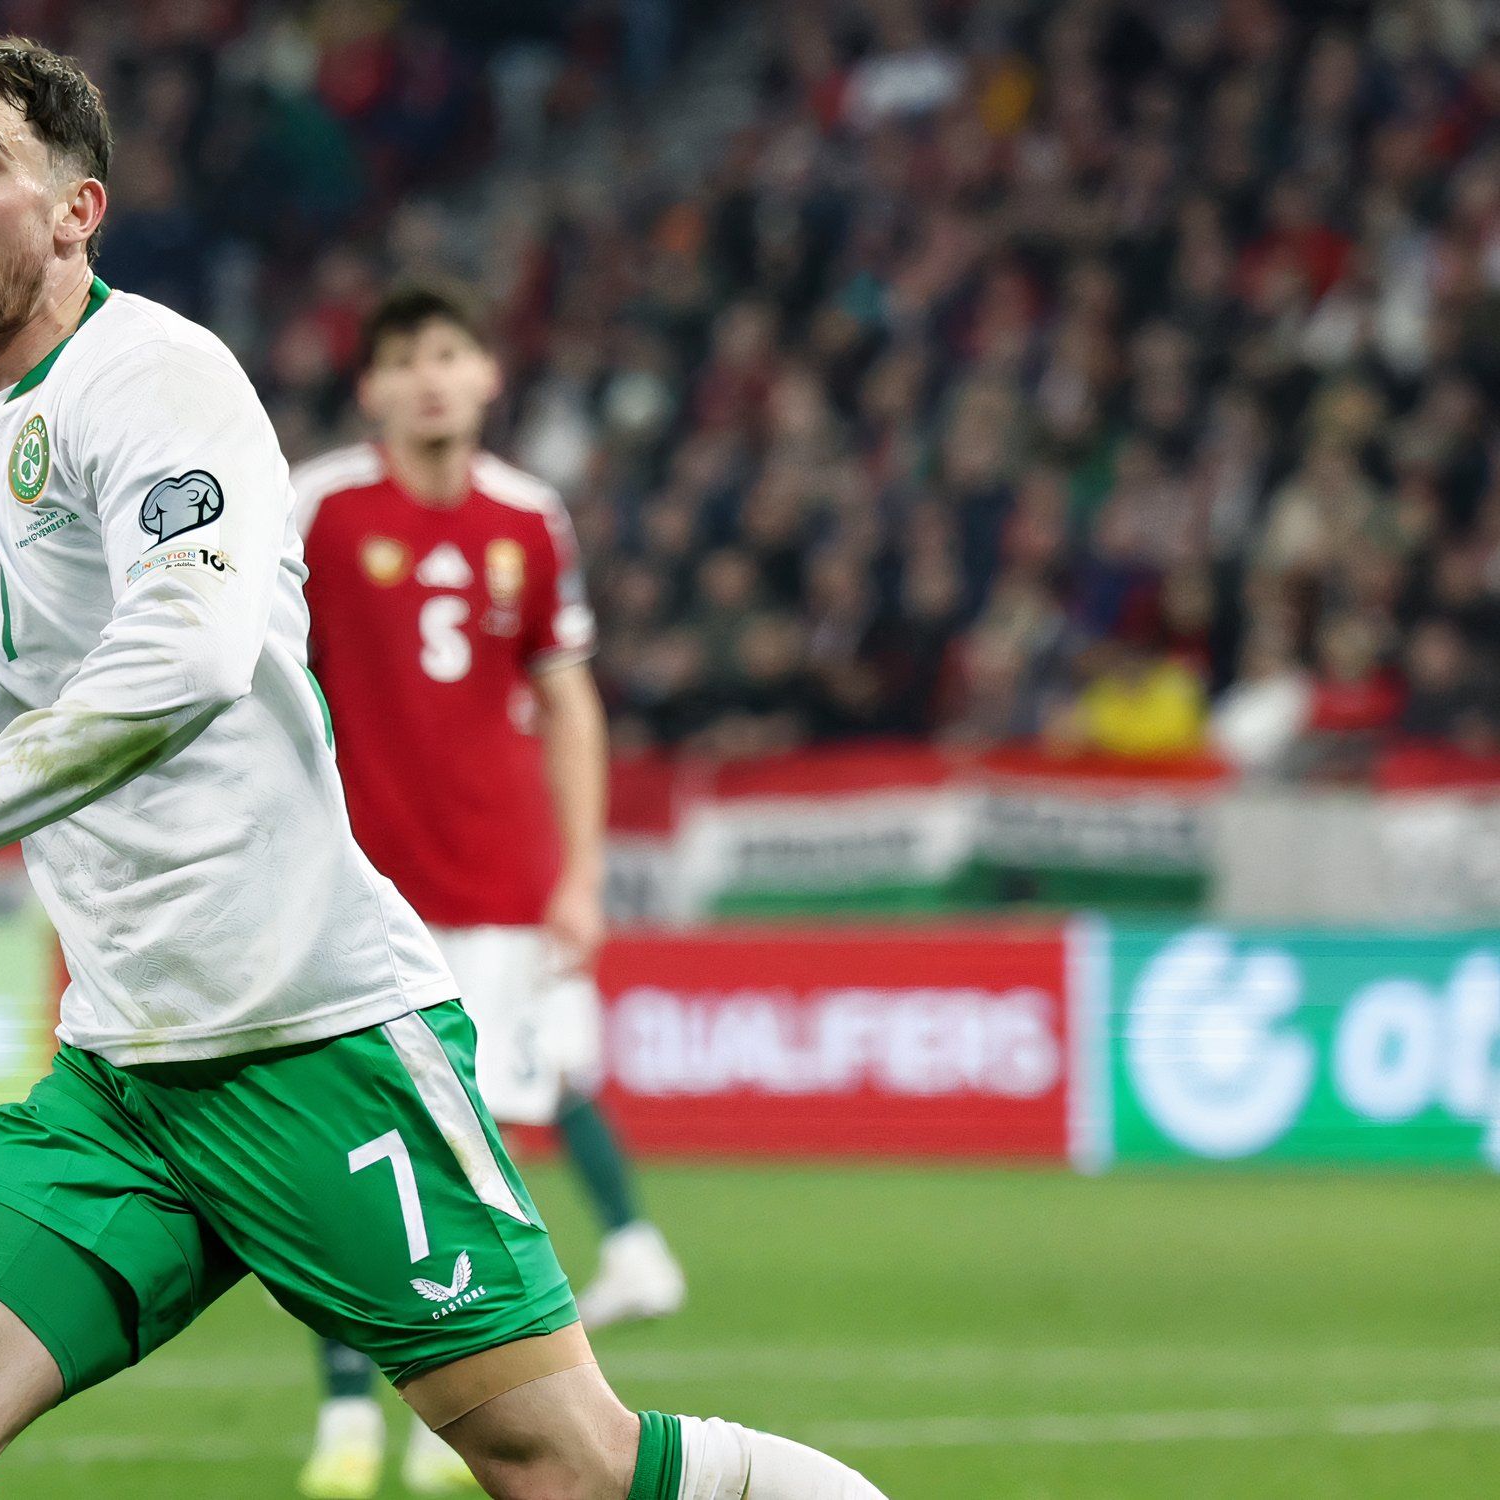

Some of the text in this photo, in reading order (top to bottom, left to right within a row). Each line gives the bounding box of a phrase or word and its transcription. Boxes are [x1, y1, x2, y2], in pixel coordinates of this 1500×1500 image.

[26, 510, 59, 532] HUNGARY
[199, 549, 226, 572] 10
[348, 1128, 430, 1265] 7
[431, 1285, 488, 1320] CASTORE
